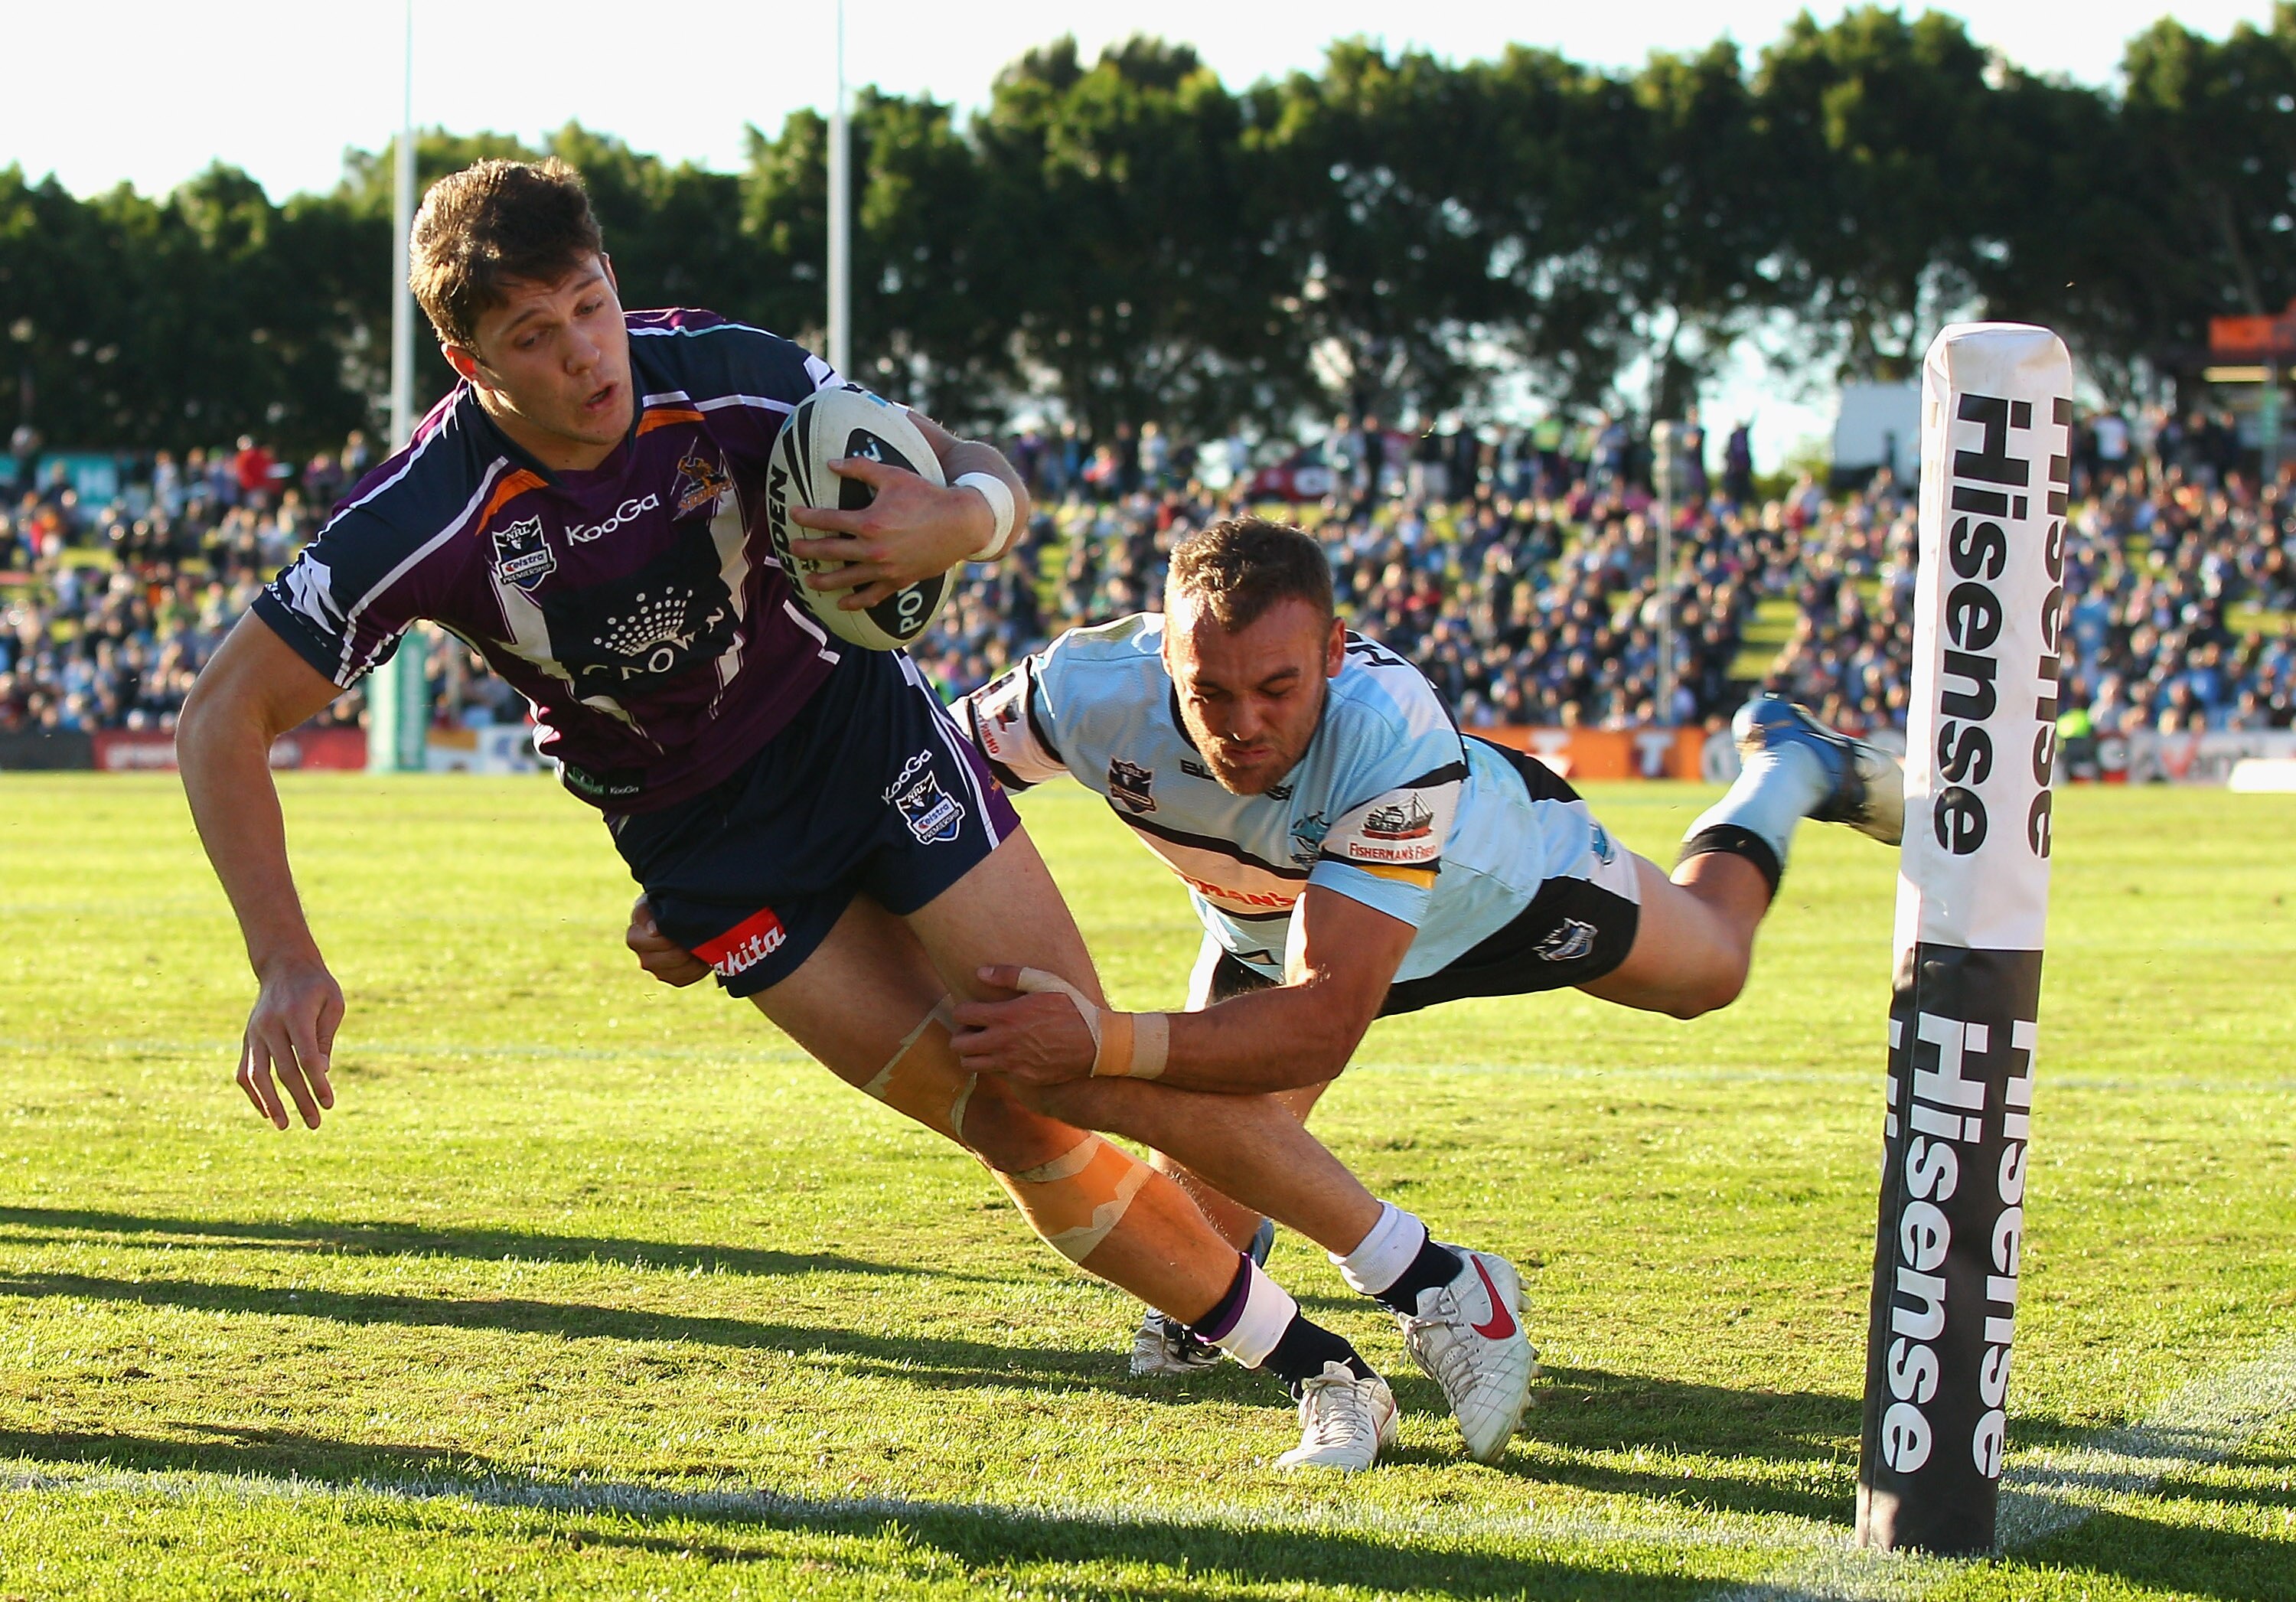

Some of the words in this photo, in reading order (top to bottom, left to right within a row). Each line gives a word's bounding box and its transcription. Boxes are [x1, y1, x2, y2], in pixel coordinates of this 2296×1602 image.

[506, 526, 530, 542] NRL
[565, 493, 660, 547] KooGa
[505, 553, 544, 572] Telstra
[1934, 393, 2031, 855] Hisense
[610, 785, 639, 794] KooGa
[881, 749, 932, 805] KooGa
[918, 803, 951, 830] Telstra
[922, 809, 960, 841] PREMIERSHIP
[1349, 843, 1414, 860] FISHERMAN'S
[710, 925, 787, 977] akita
[1883, 1011, 1989, 1473] Hisense
